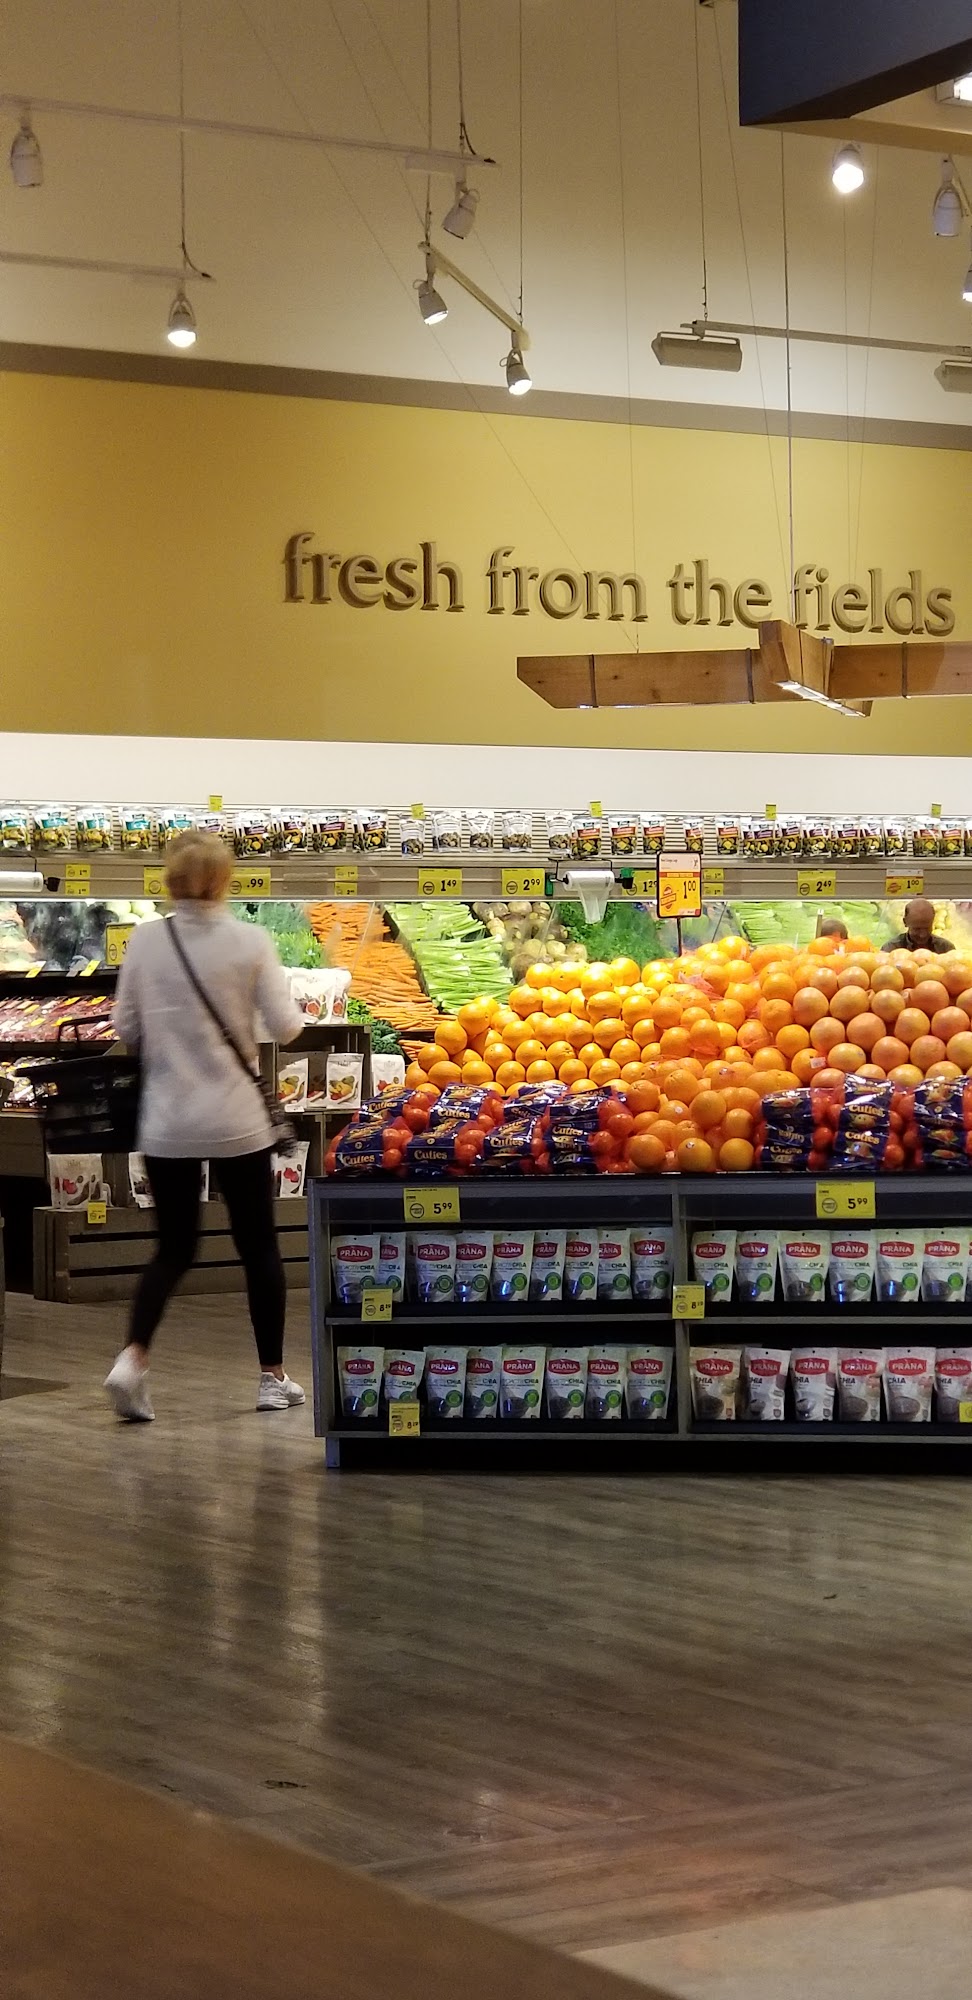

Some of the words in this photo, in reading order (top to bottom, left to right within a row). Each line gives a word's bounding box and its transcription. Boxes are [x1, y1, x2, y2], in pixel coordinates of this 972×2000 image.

[282, 531, 466, 613] fresh
[485, 545, 648, 620] from
[666, 558, 773, 628] the
[790, 563, 957, 637] fields
[368, 1102, 398, 1112] Cuties
[490, 1137, 525, 1147] Cuties
[414, 1150, 448, 1160] Cuties
